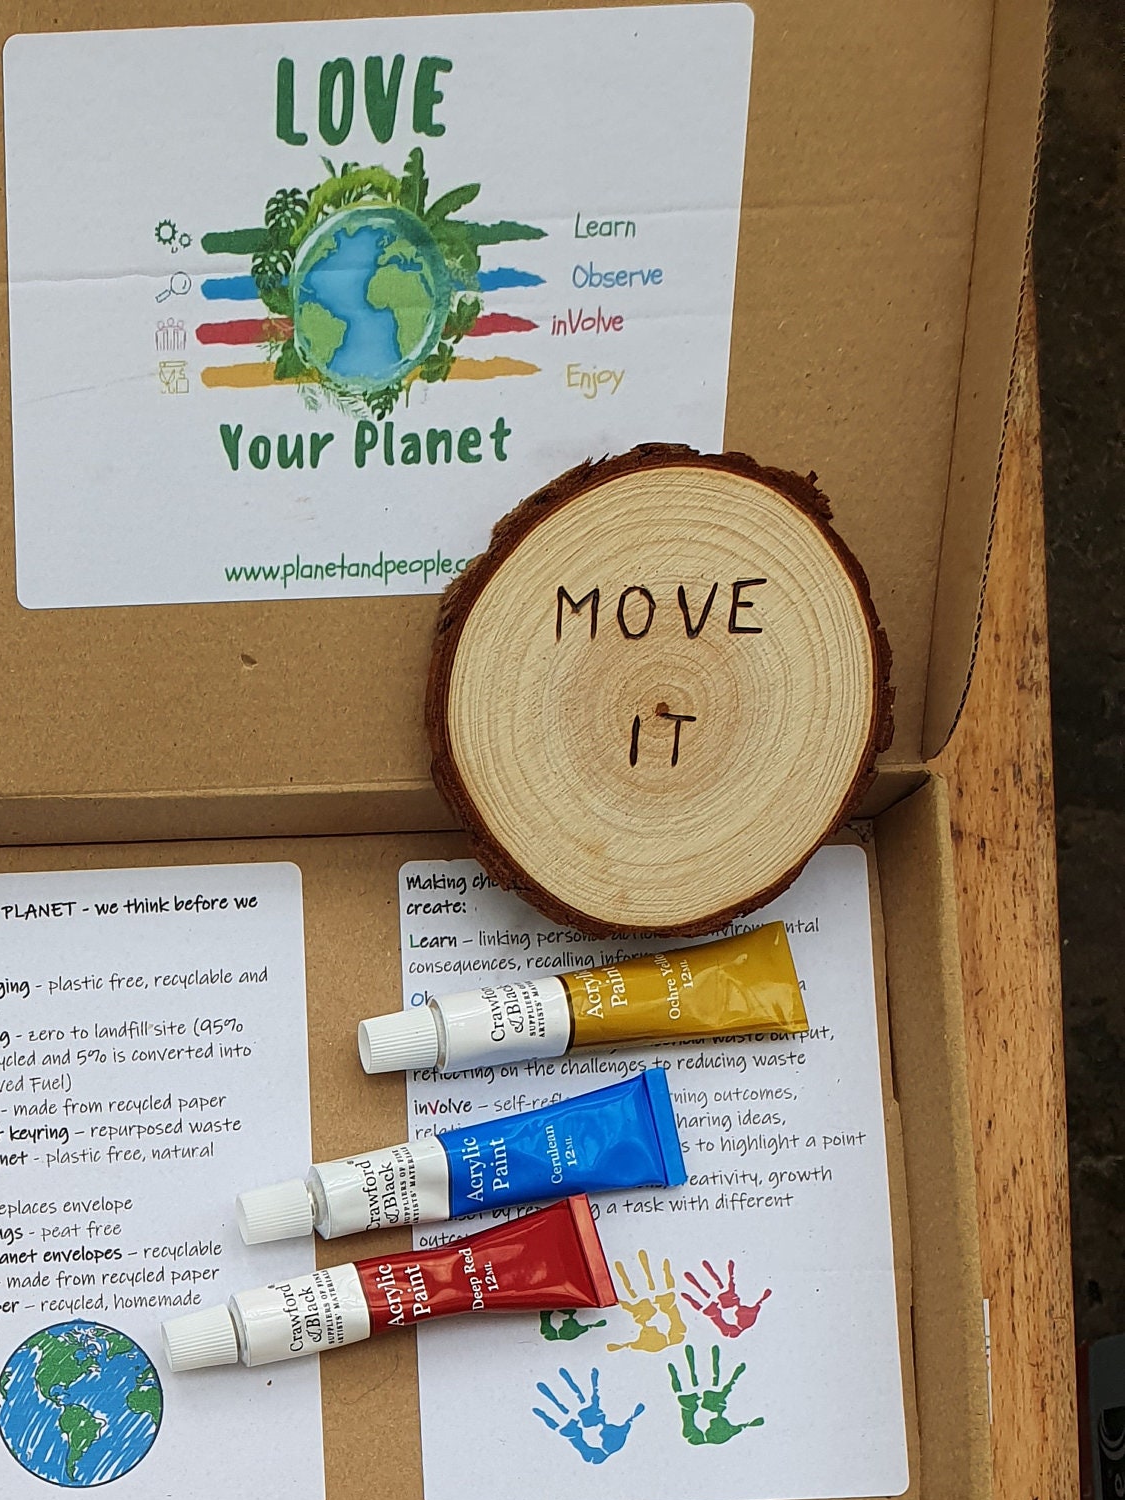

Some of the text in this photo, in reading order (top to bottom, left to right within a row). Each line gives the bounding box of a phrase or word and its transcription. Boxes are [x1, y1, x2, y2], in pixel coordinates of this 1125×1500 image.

[276, 53, 453, 147] LOVE
[574, 211, 636, 239] Learn
[572, 260, 663, 289] Observe
[551, 305, 624, 337] inVolve
[566, 362, 626, 400] Enjoy
[219, 416, 512, 472] Your Planet
[556, 578, 768, 640] MOVE
[629, 713, 697, 767] IT
[0, 901, 77, 921] PLANET
[94, 902, 119, 916] we
[122, 896, 170, 914] think
[173, 894, 229, 913] before
[233, 896, 258, 910] we
[406, 899, 467, 916] create:
[48, 974, 104, 996] plastic
[108, 972, 149, 991] free,
[154, 968, 233, 990] recyclable
[238, 965, 268, 983] and
[666, 978, 684, 1021] Ochre
[488, 1137, 510, 1192] Paint
[545, 1124, 563, 1184] Cerulean
[694, 1131, 867, 1157] to highlight a point
[461, 1136, 489, 1202] Acrylic
[606, 1192, 794, 1214] a task with different
[40, 1223, 82, 1243] peat
[86, 1220, 122, 1239] free
[375, 1263, 405, 1326] Acrylic
[402, 1262, 431, 1318] Paint
[458, 1247, 485, 1310] Deep Red
[275, 1283, 306, 1352] Crawford
